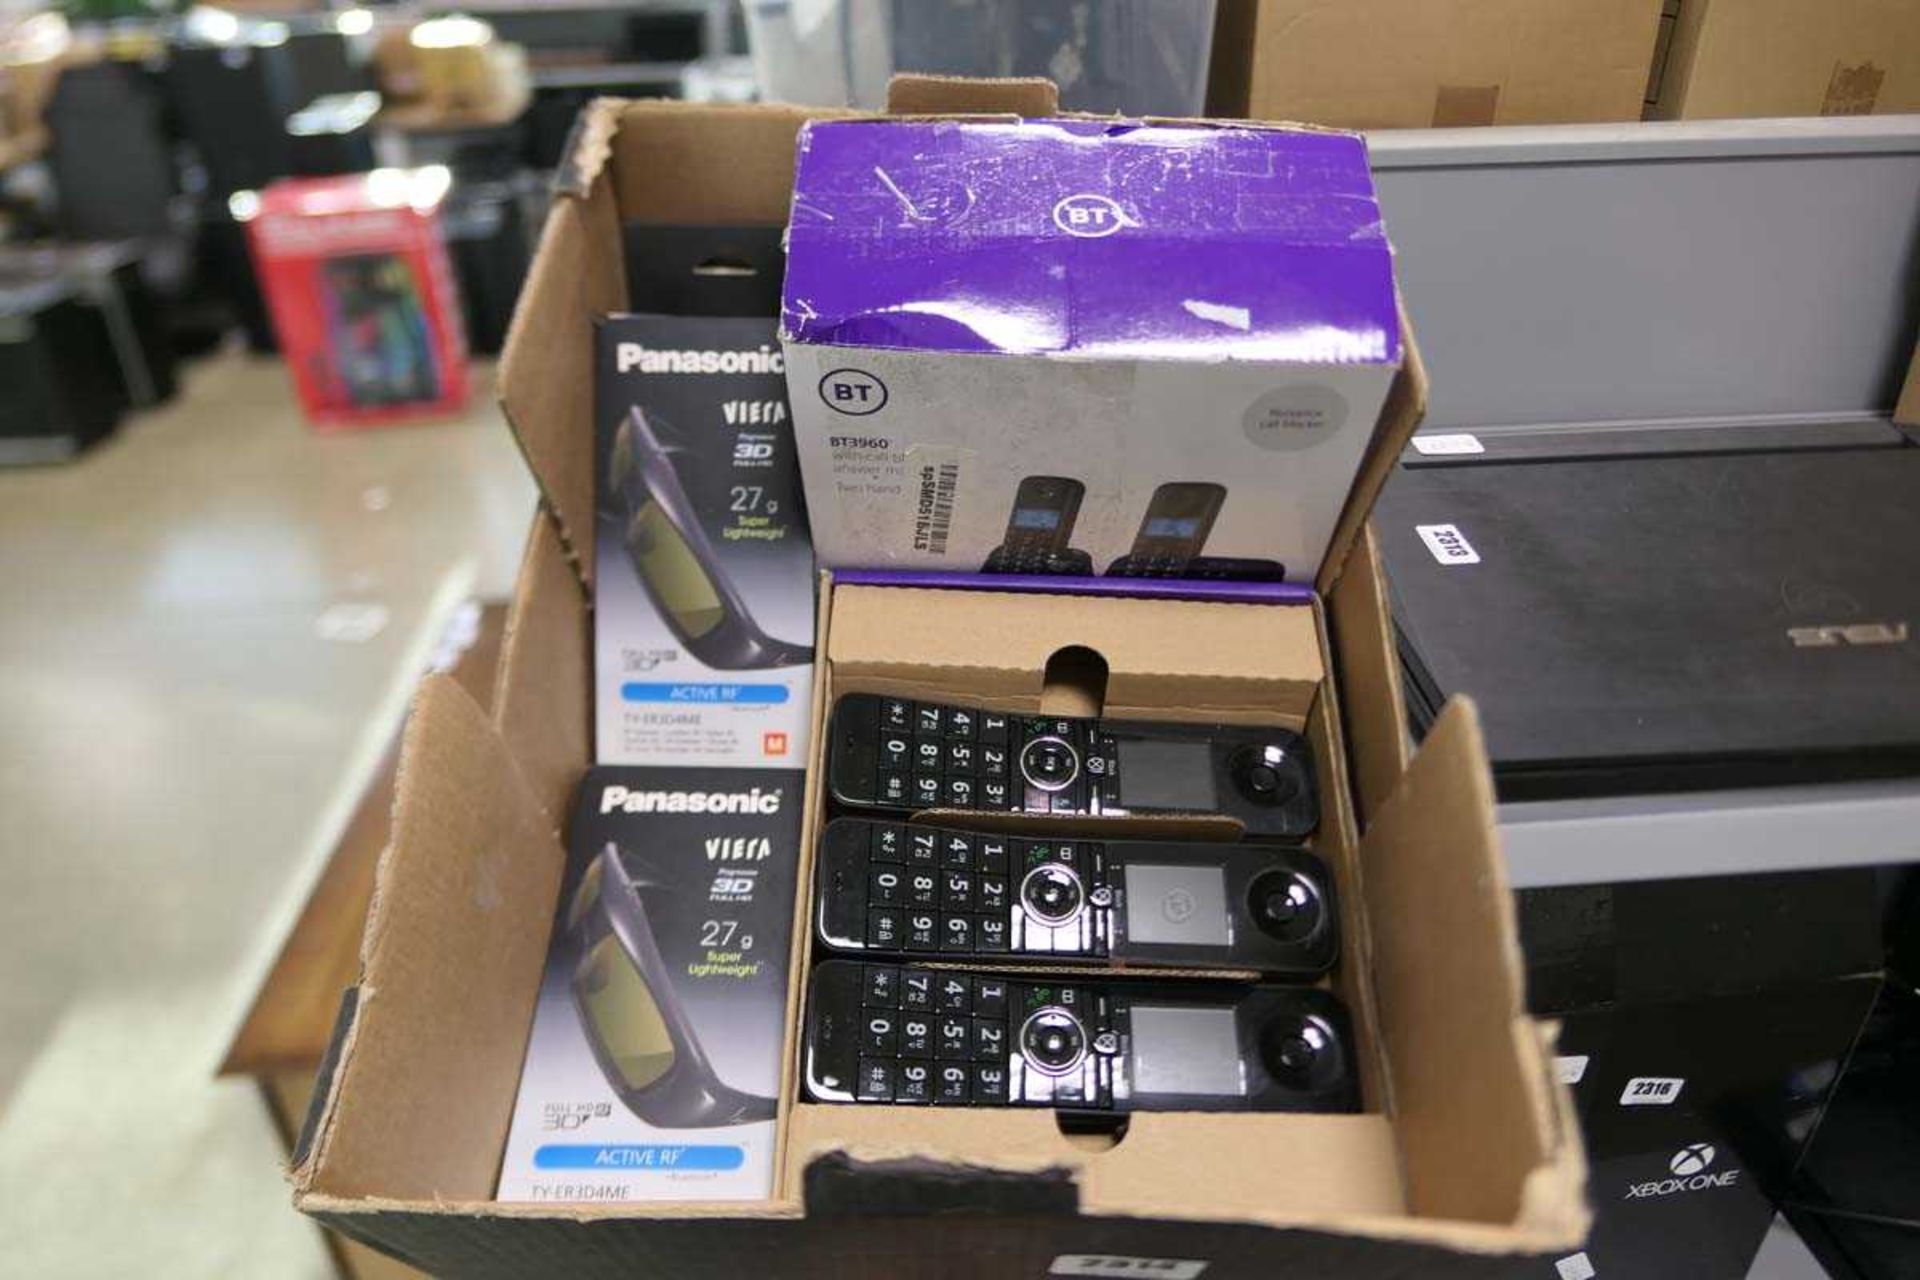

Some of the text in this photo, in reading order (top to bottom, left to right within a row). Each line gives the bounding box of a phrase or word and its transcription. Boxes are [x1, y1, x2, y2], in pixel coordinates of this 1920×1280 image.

[1069, 208, 1108, 224] BT
[616, 342, 784, 374] Panasonic
[834, 383, 872, 401] BT
[722, 400, 786, 424] VIERA
[829, 436, 889, 449] BT3960
[730, 486, 779, 514] 27 g
[1433, 530, 1469, 557] 2313
[921, 708, 939, 723] 7
[953, 712, 970, 725] 4
[987, 717, 1004, 729] 1
[887, 740, 905, 753] 0
[920, 745, 938, 757] 8
[953, 747, 970, 760] 5
[986, 752, 1003, 763] 2
[919, 779, 937, 791] 9
[953, 782, 970, 793] 6
[986, 785, 1004, 796] 3
[600, 784, 780, 815] Panasonic
[914, 835, 934, 848] 7
[949, 838, 968, 851] 4
[704, 837, 771, 861] VIERA
[985, 844, 1003, 856] 1
[710, 878, 755, 893] 3D
[878, 873, 897, 887] 0
[914, 876, 933, 889] 8
[950, 880, 968, 892] 5
[984, 883, 1003, 895] 2
[913, 917, 932, 930] 9
[949, 919, 968, 932] 6
[984, 920, 1002, 932] 3
[700, 920, 753, 949] 27 g
[707, 950, 742, 964] Super
[688, 963, 759, 978] Lightweight
[908, 978, 928, 991] 7
[944, 981, 964, 995] 4
[982, 986, 1001, 998] 1
[870, 1019, 890, 1033] 0
[907, 1022, 927, 1036] 8
[944, 1026, 964, 1038] 5
[981, 1028, 1001, 1041] 2
[906, 1067, 926, 1080] 9
[944, 1068, 964, 1081] 6
[981, 1070, 1001, 1083] 3
[594, 1148, 654, 1166] ACTIVE
[1624, 1169, 1740, 1199] XBOX ONE
